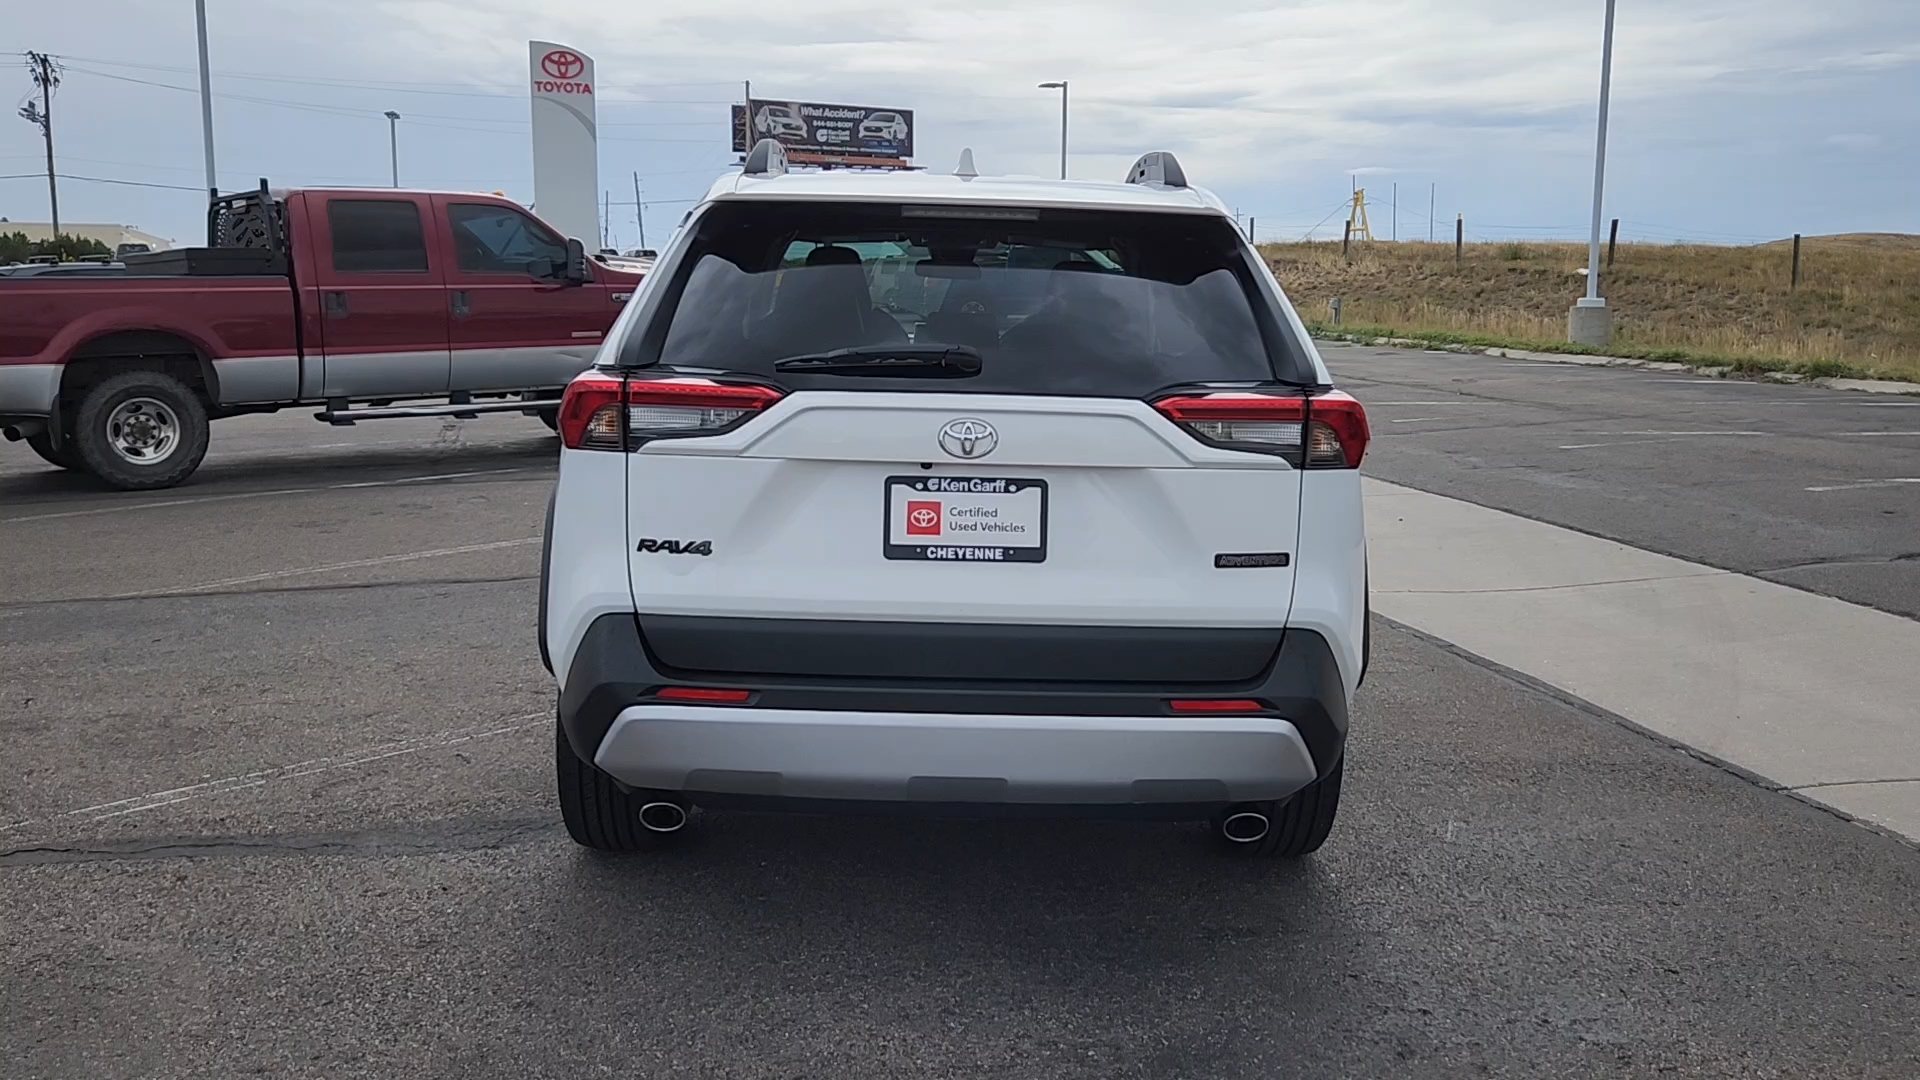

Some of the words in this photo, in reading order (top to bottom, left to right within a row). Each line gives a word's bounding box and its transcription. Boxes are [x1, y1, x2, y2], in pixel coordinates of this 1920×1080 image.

[534, 81, 593, 95] TOYOTA
[800, 106, 822, 117] What
[823, 107, 866, 119] Accident?
[940, 478, 968, 491] Ken
[969, 479, 1006, 492] Garff
[949, 507, 998, 518] Certified
[949, 521, 977, 531] Used
[979, 522, 1026, 533] Vehicles
[636, 538, 713, 556] RAV4
[926, 547, 1004, 560] CHEYENNE
